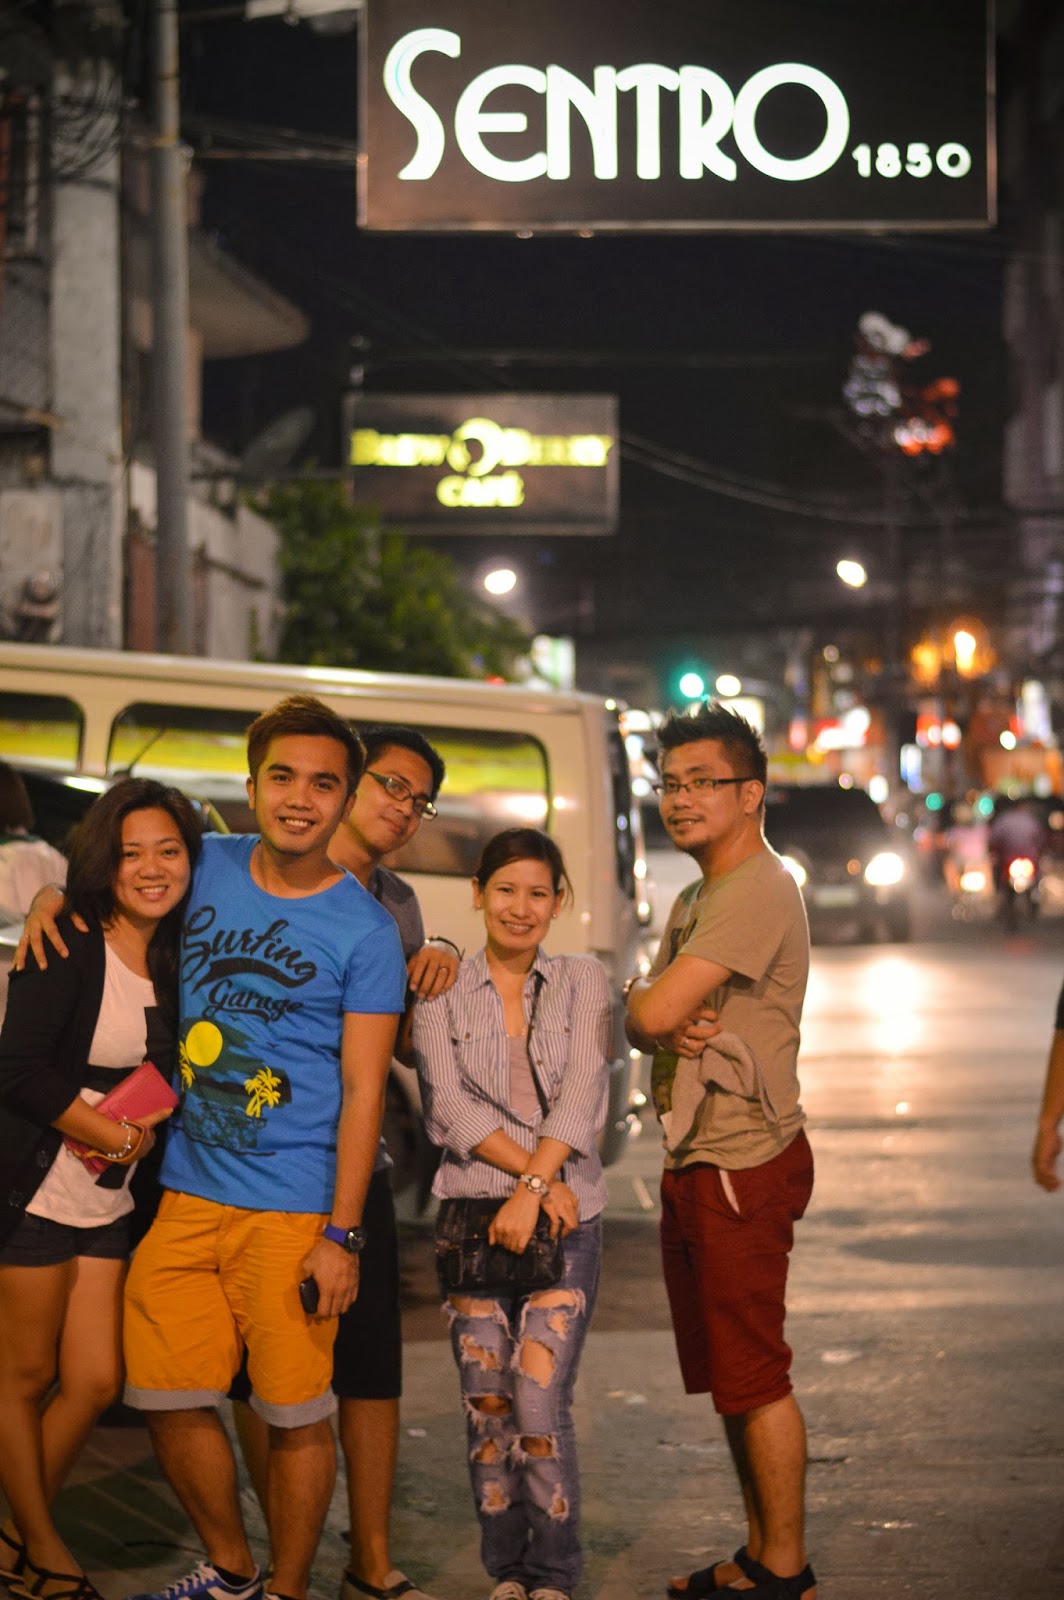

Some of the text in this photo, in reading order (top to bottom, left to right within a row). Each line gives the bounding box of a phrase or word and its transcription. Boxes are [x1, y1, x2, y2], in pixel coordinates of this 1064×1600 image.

[383, 27, 972, 183] SENTRO 1850
[181, 905, 317, 985] Surfing
[202, 978, 304, 1022] Garage
